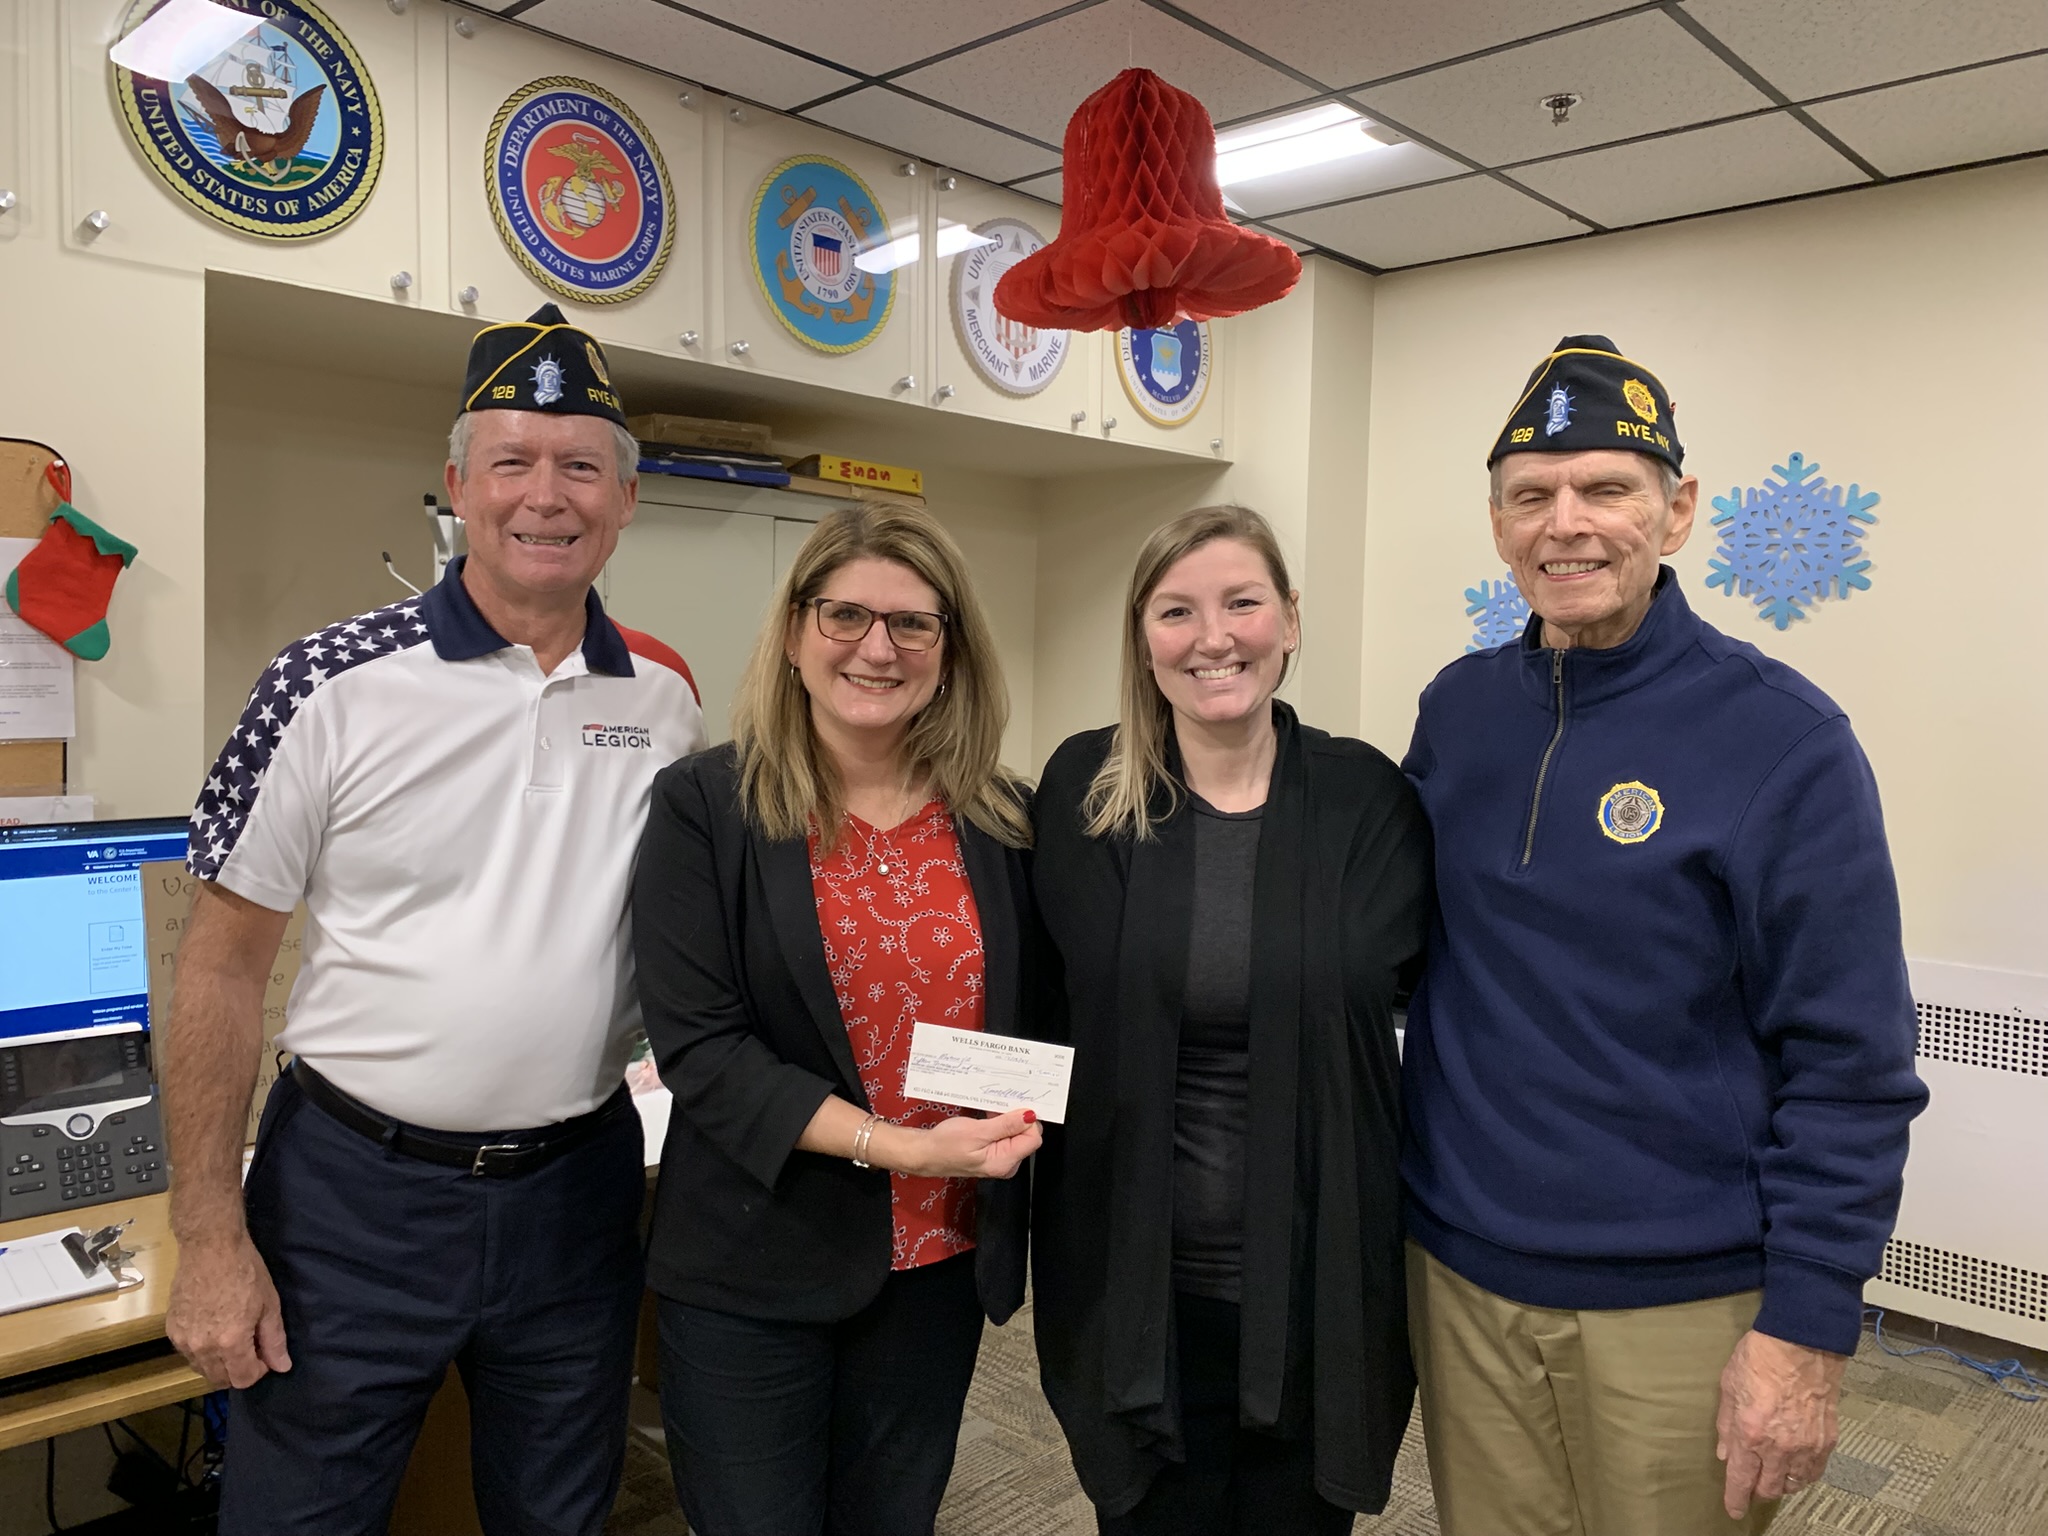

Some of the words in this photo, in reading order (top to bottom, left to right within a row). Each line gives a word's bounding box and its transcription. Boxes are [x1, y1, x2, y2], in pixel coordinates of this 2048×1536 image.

[261, 1, 289, 21] OF
[298, 20, 333, 61] THE
[330, 60, 363, 116] NAVY
[141, 89, 194, 170] UNITED
[192, 169, 268, 215] STATES
[274, 199, 300, 217] OF
[307, 148, 363, 212] AMERICA
[504, 98, 591, 169] DEPARTMENT
[593, 109, 611, 125] OF
[613, 120, 636, 149] THE
[633, 152, 660, 205] NAVY
[798, 211, 830, 233] STATES
[831, 216, 856, 249] COAST
[506, 185, 540, 247] UNITED
[539, 246, 585, 281] STATES
[590, 259, 637, 283] MARINE
[634, 221, 657, 262] CORPS
[793, 232, 810, 281] UNITED
[817, 286, 839, 299] 1790
[966, 308, 1010, 377] MERCHANT
[1028, 336, 1062, 381] MARINE
[491, 385, 516, 400] 128
[1510, 427, 1535, 444] 128
[1655, 431, 1670, 452] NY
[839, 460, 892, 482] MSDS
[582, 732, 652, 749] LEGION
[603, 726, 649, 735] AMERICAN
[1609, 788, 1657, 812] AMERICAN
[87, 850, 99, 858] VA
[87, 874, 138, 885] WELCOME
[951, 1036, 979, 1046] WELLS
[980, 1040, 1007, 1051] FARGO
[1008, 1045, 1031, 1055] BANK
